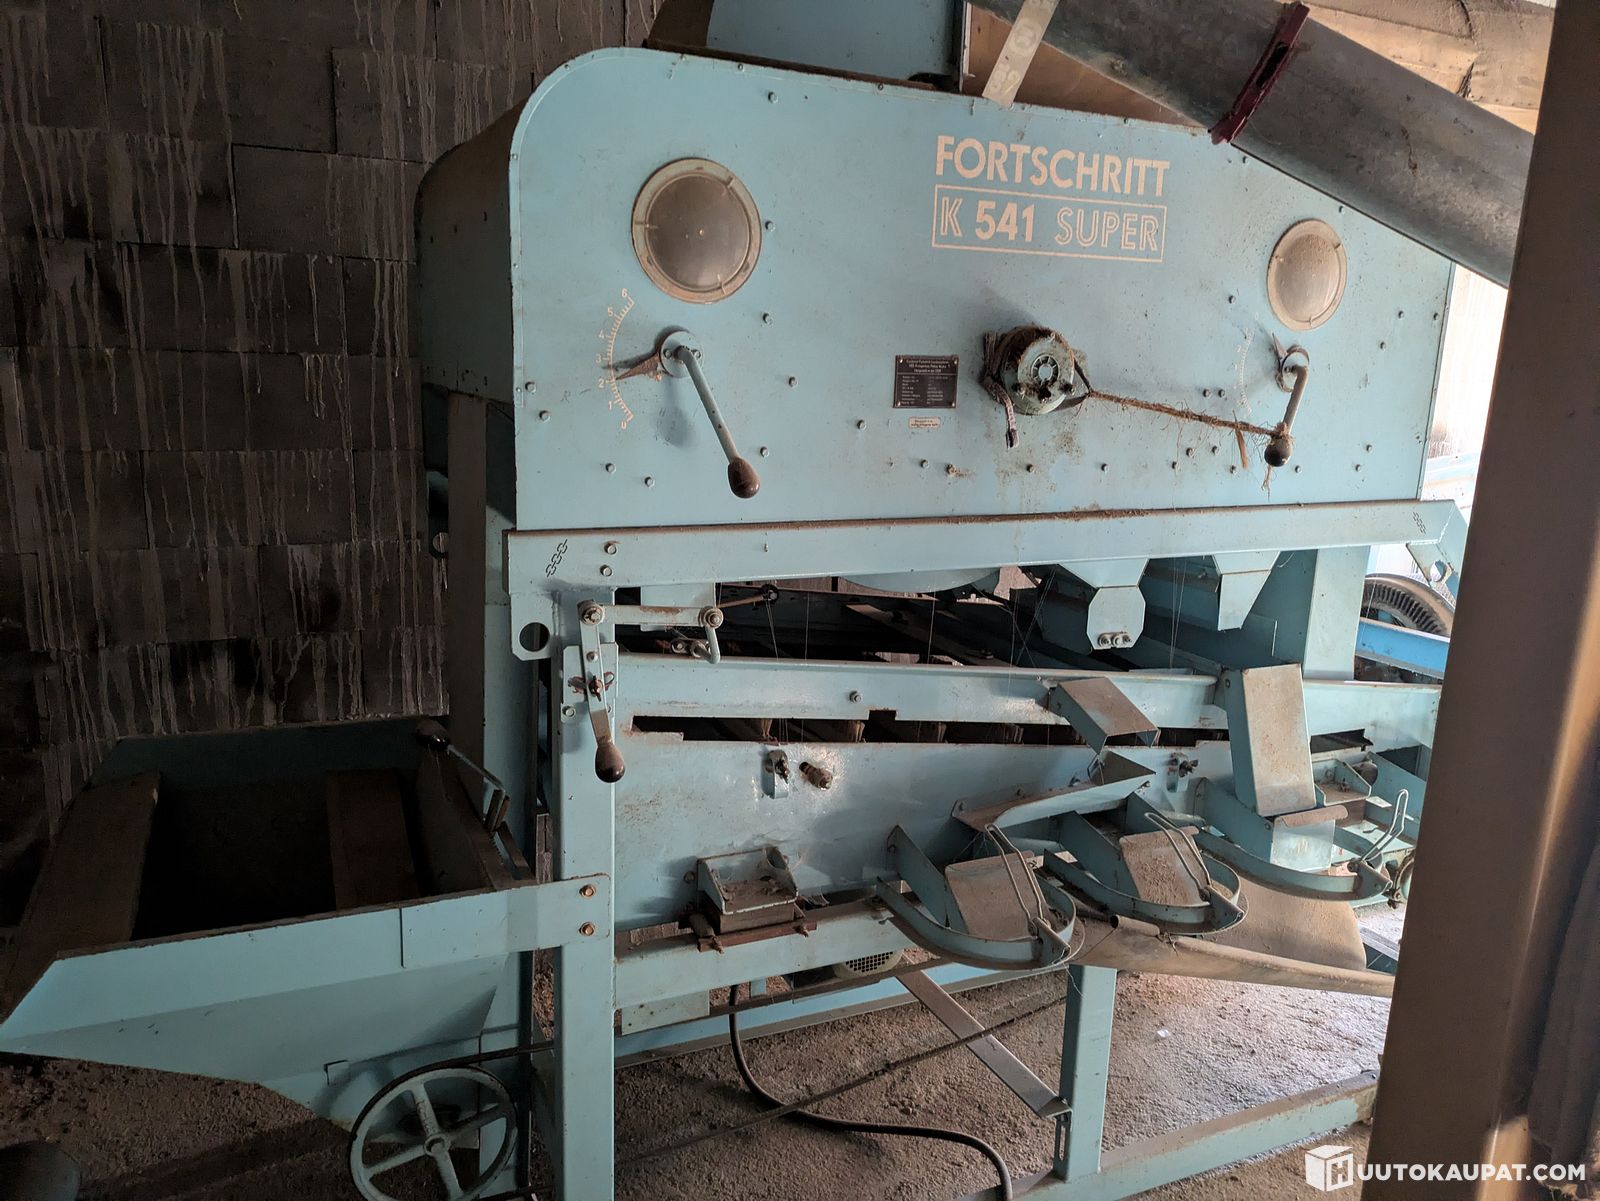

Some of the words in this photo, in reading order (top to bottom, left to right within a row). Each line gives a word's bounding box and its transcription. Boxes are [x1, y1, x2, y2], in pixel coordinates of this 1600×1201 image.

[935, 134, 1170, 197] FORTSCHRITT
[940, 195, 964, 237] K
[975, 199, 1035, 243] 541
[1055, 206, 1159, 252] SUPER
[621, 288, 628, 298] 6
[608, 307, 613, 317] 5
[598, 330, 605, 339] 4
[595, 354, 602, 363] 3
[598, 378, 605, 388] 2
